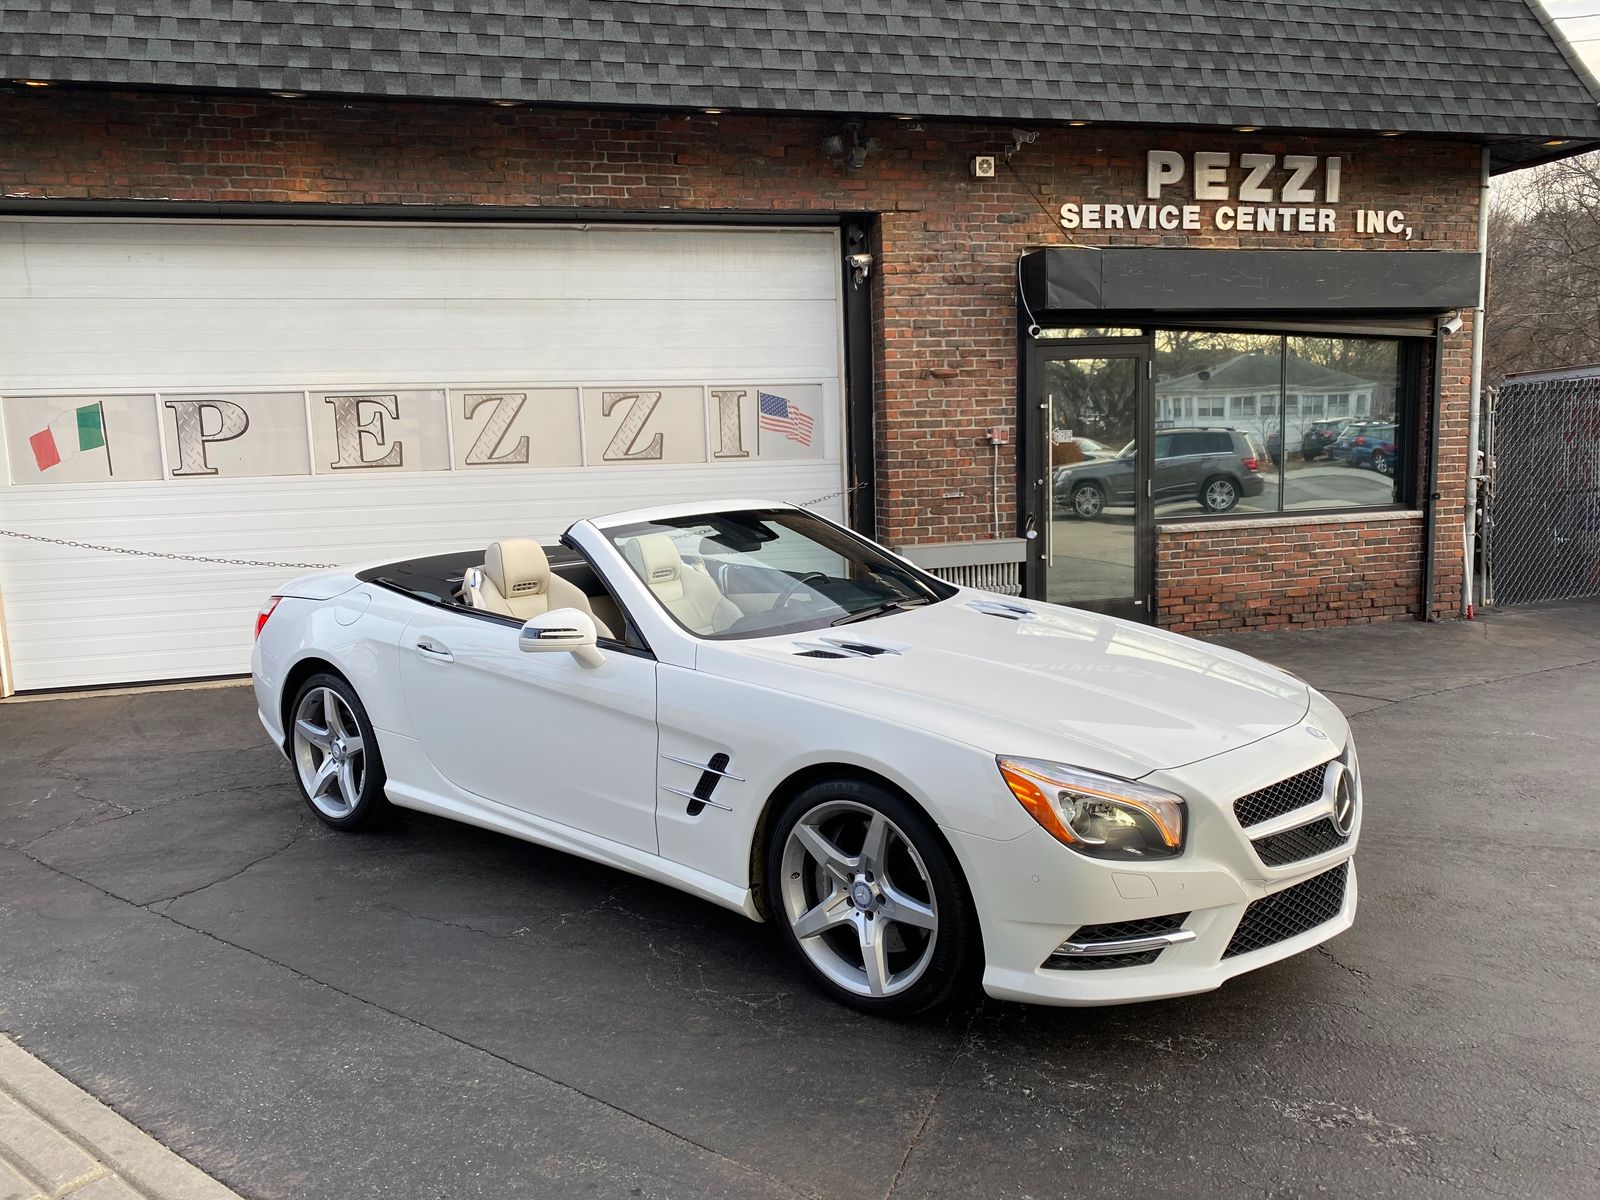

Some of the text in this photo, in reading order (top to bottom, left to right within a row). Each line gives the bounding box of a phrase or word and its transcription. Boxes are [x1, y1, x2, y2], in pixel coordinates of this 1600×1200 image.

[1146, 149, 1342, 203] PEZZI
[1060, 203, 1413, 241] SERVICE CENTER INC,
[165, 389, 750, 476] PEZZI
